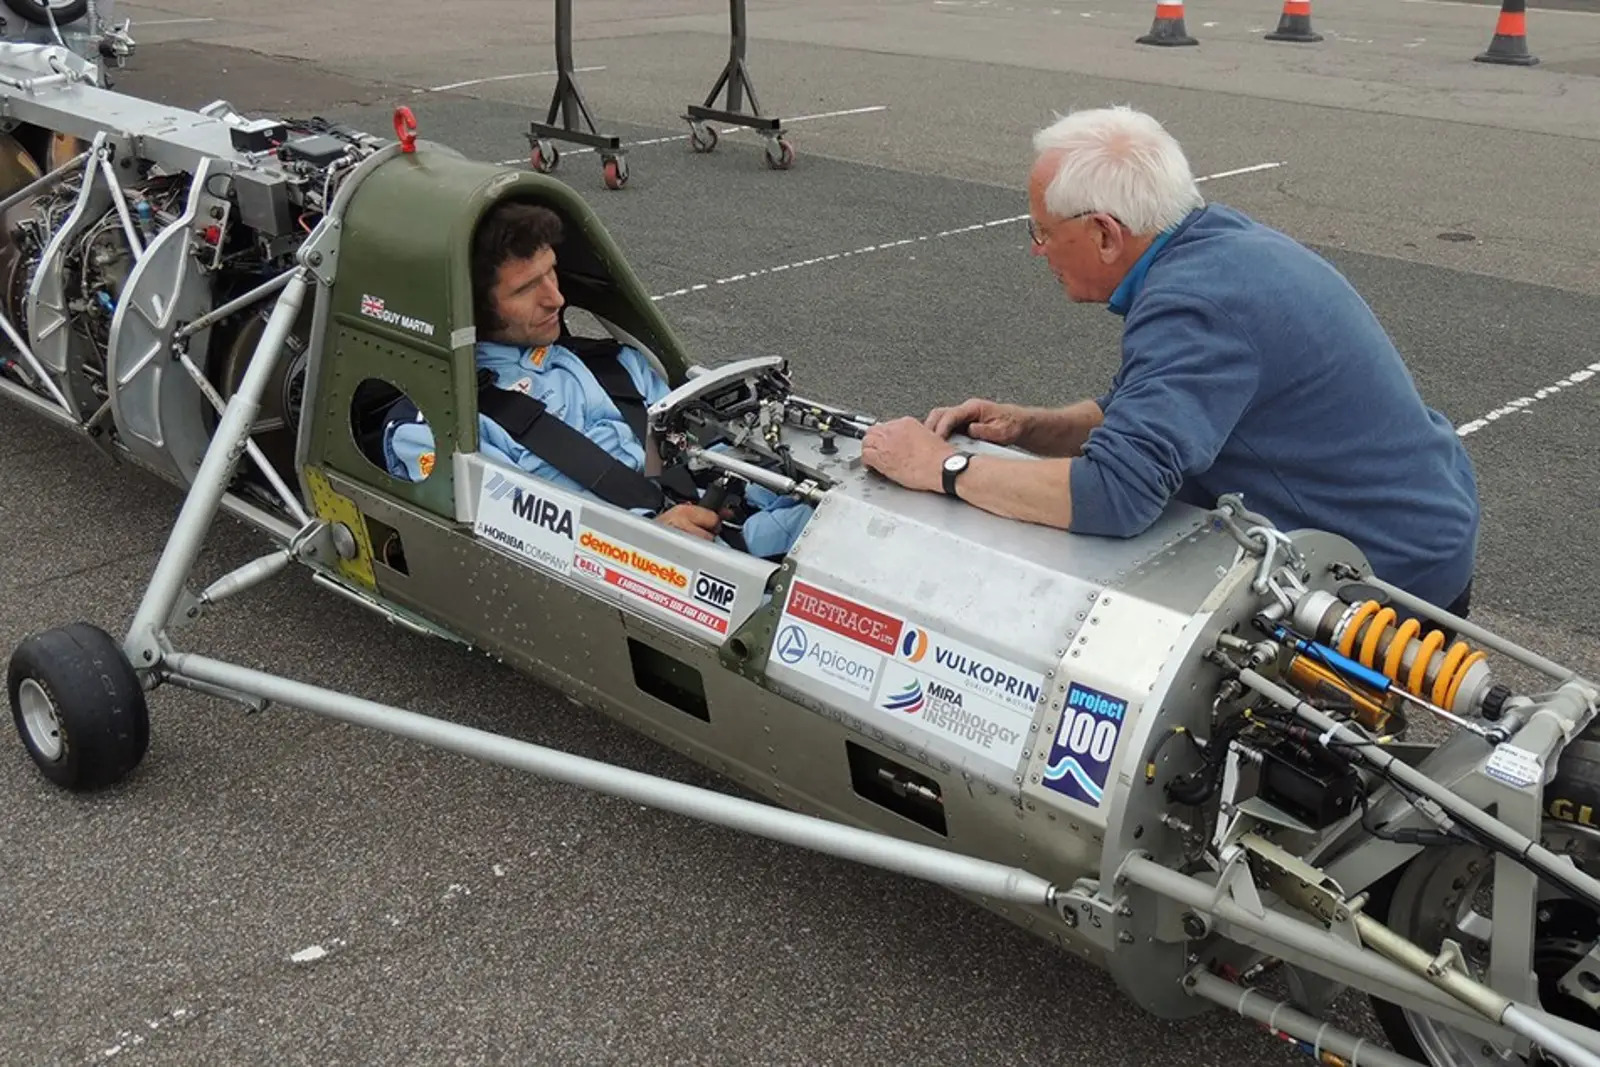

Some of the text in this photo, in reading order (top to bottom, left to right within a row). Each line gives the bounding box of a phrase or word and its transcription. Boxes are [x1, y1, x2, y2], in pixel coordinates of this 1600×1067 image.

[383, 309, 434, 336] GUY MARTIN
[512, 486, 574, 541] MIRA
[484, 524, 524, 551] HORIBA
[524, 543, 569, 572] COMPANY
[579, 557, 603, 577] BELL
[580, 531, 687, 589] demon tweeks
[695, 577, 735, 607] OMP
[791, 590, 884, 640] FIRETRACE
[807, 642, 875, 683] Apicom
[935, 646, 1040, 703] VULKOPRIN
[926, 681, 964, 708] MIRA
[1069, 687, 1125, 721] project
[921, 708, 994, 749] INSTITUTE
[924, 694, 1021, 746] TECHNOLOGY
[1056, 706, 1118, 763] 100
